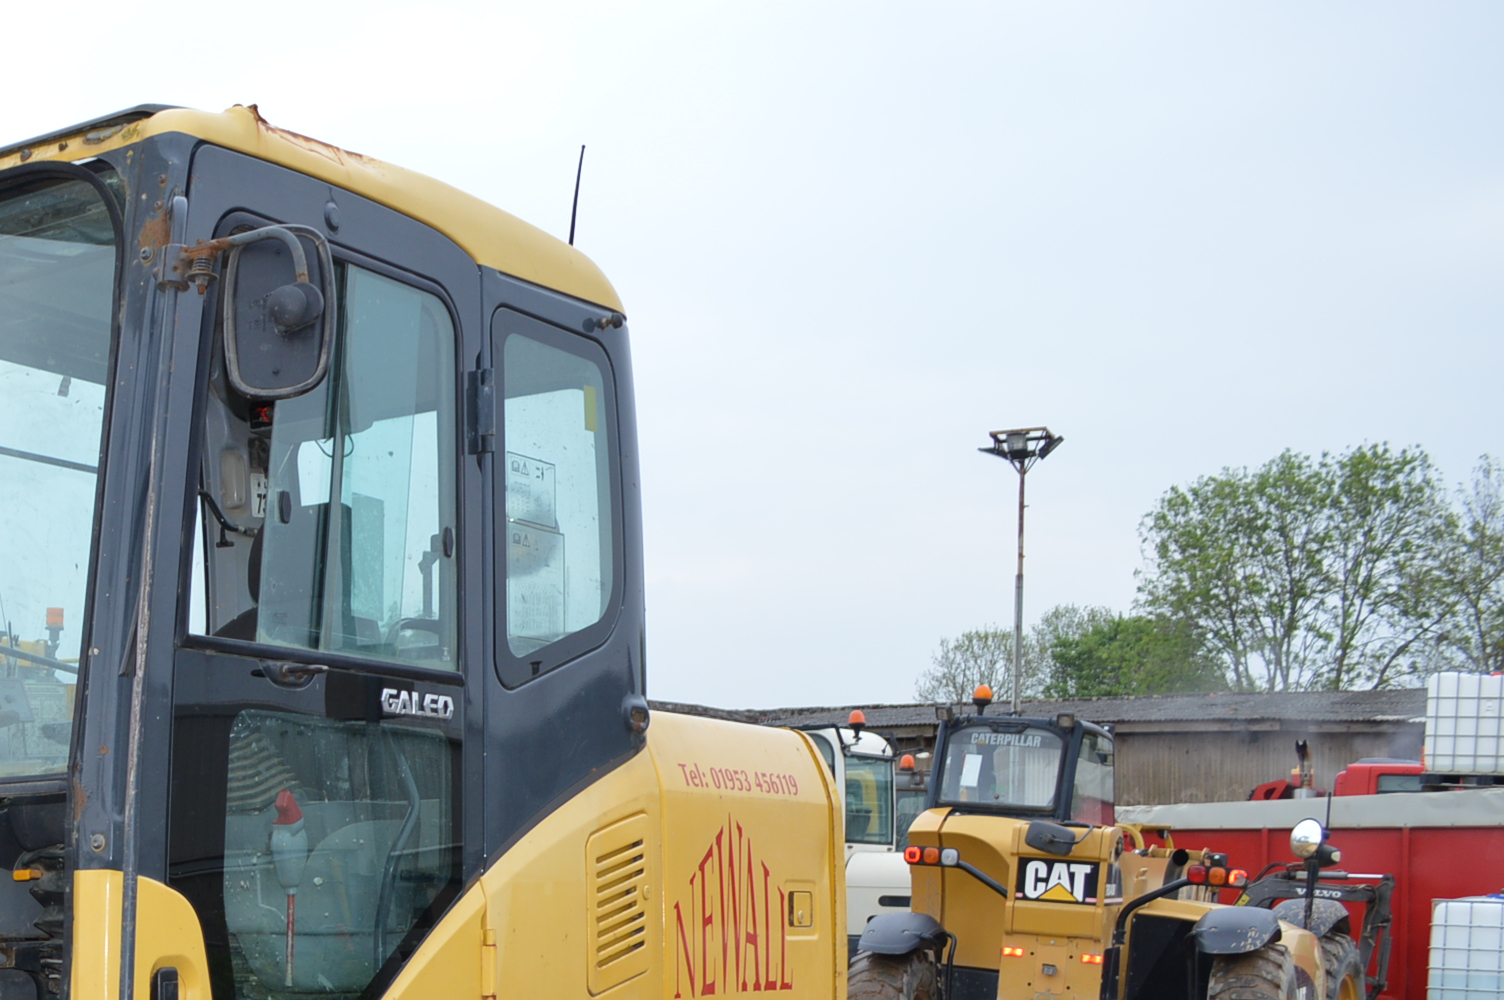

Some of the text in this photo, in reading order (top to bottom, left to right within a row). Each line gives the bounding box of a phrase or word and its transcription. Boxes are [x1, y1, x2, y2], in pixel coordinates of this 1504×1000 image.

[971, 732, 1042, 748] CATERPILLAR
[677, 762, 799, 796] Tel: 01953 456119
[1024, 860, 1091, 902] CAT
[1295, 887, 1342, 898] VLVO
[674, 811, 794, 1000] NEWALL
